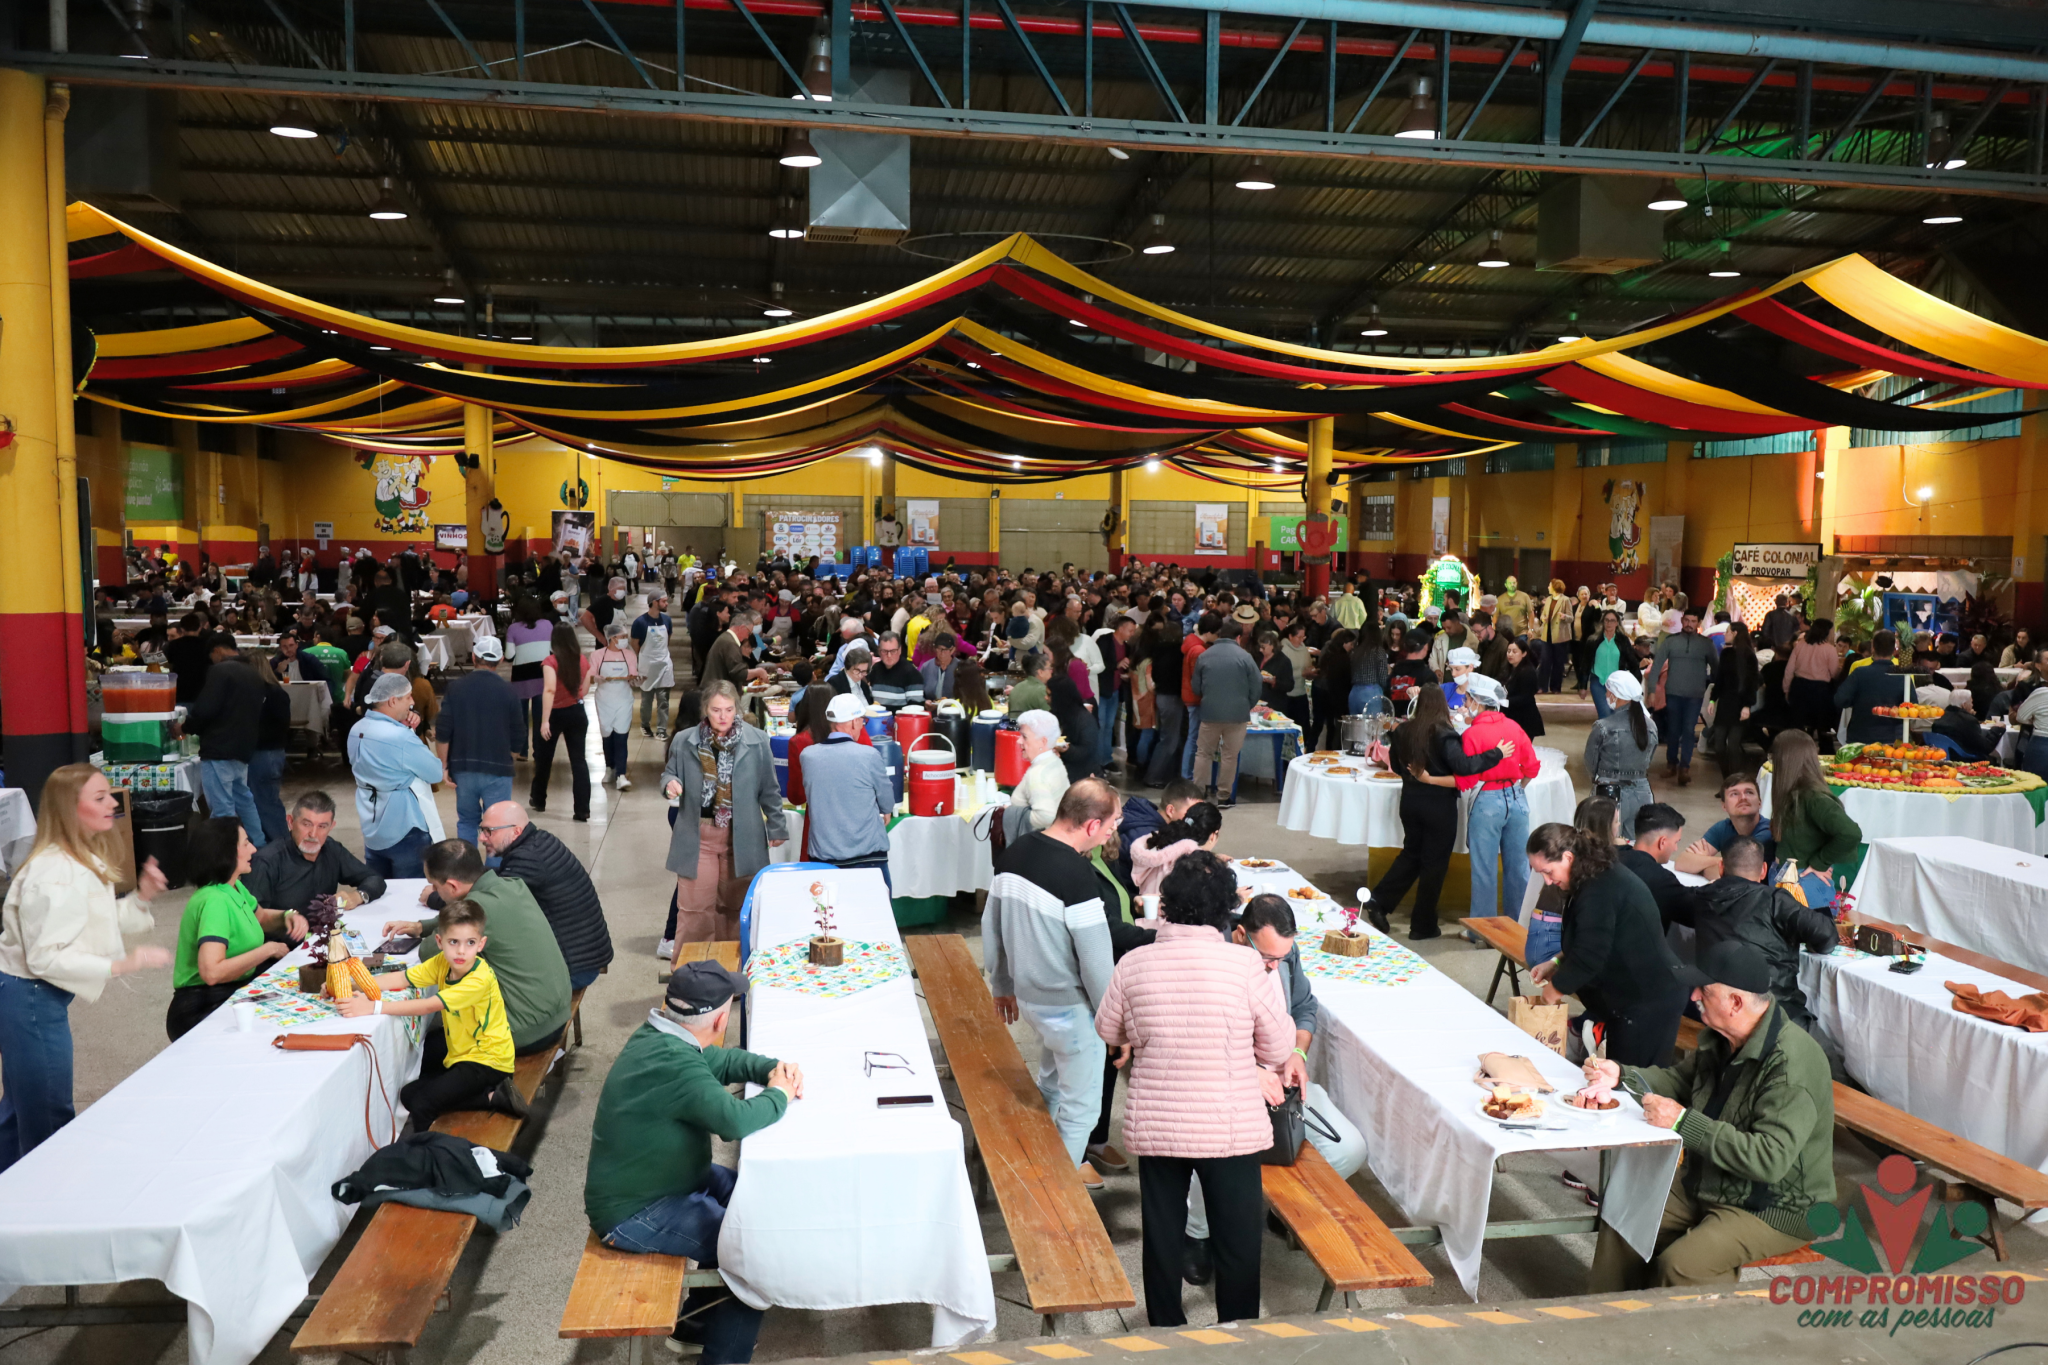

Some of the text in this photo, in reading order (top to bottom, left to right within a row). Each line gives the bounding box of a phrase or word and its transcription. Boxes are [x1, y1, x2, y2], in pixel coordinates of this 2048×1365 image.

[779, 514, 840, 523] PATROCINADORES
[1281, 526, 1306, 535] Page
[1734, 547, 1817, 565] CAFÉ COLONIAL
[1752, 566, 1791, 576] PROVOPAR
